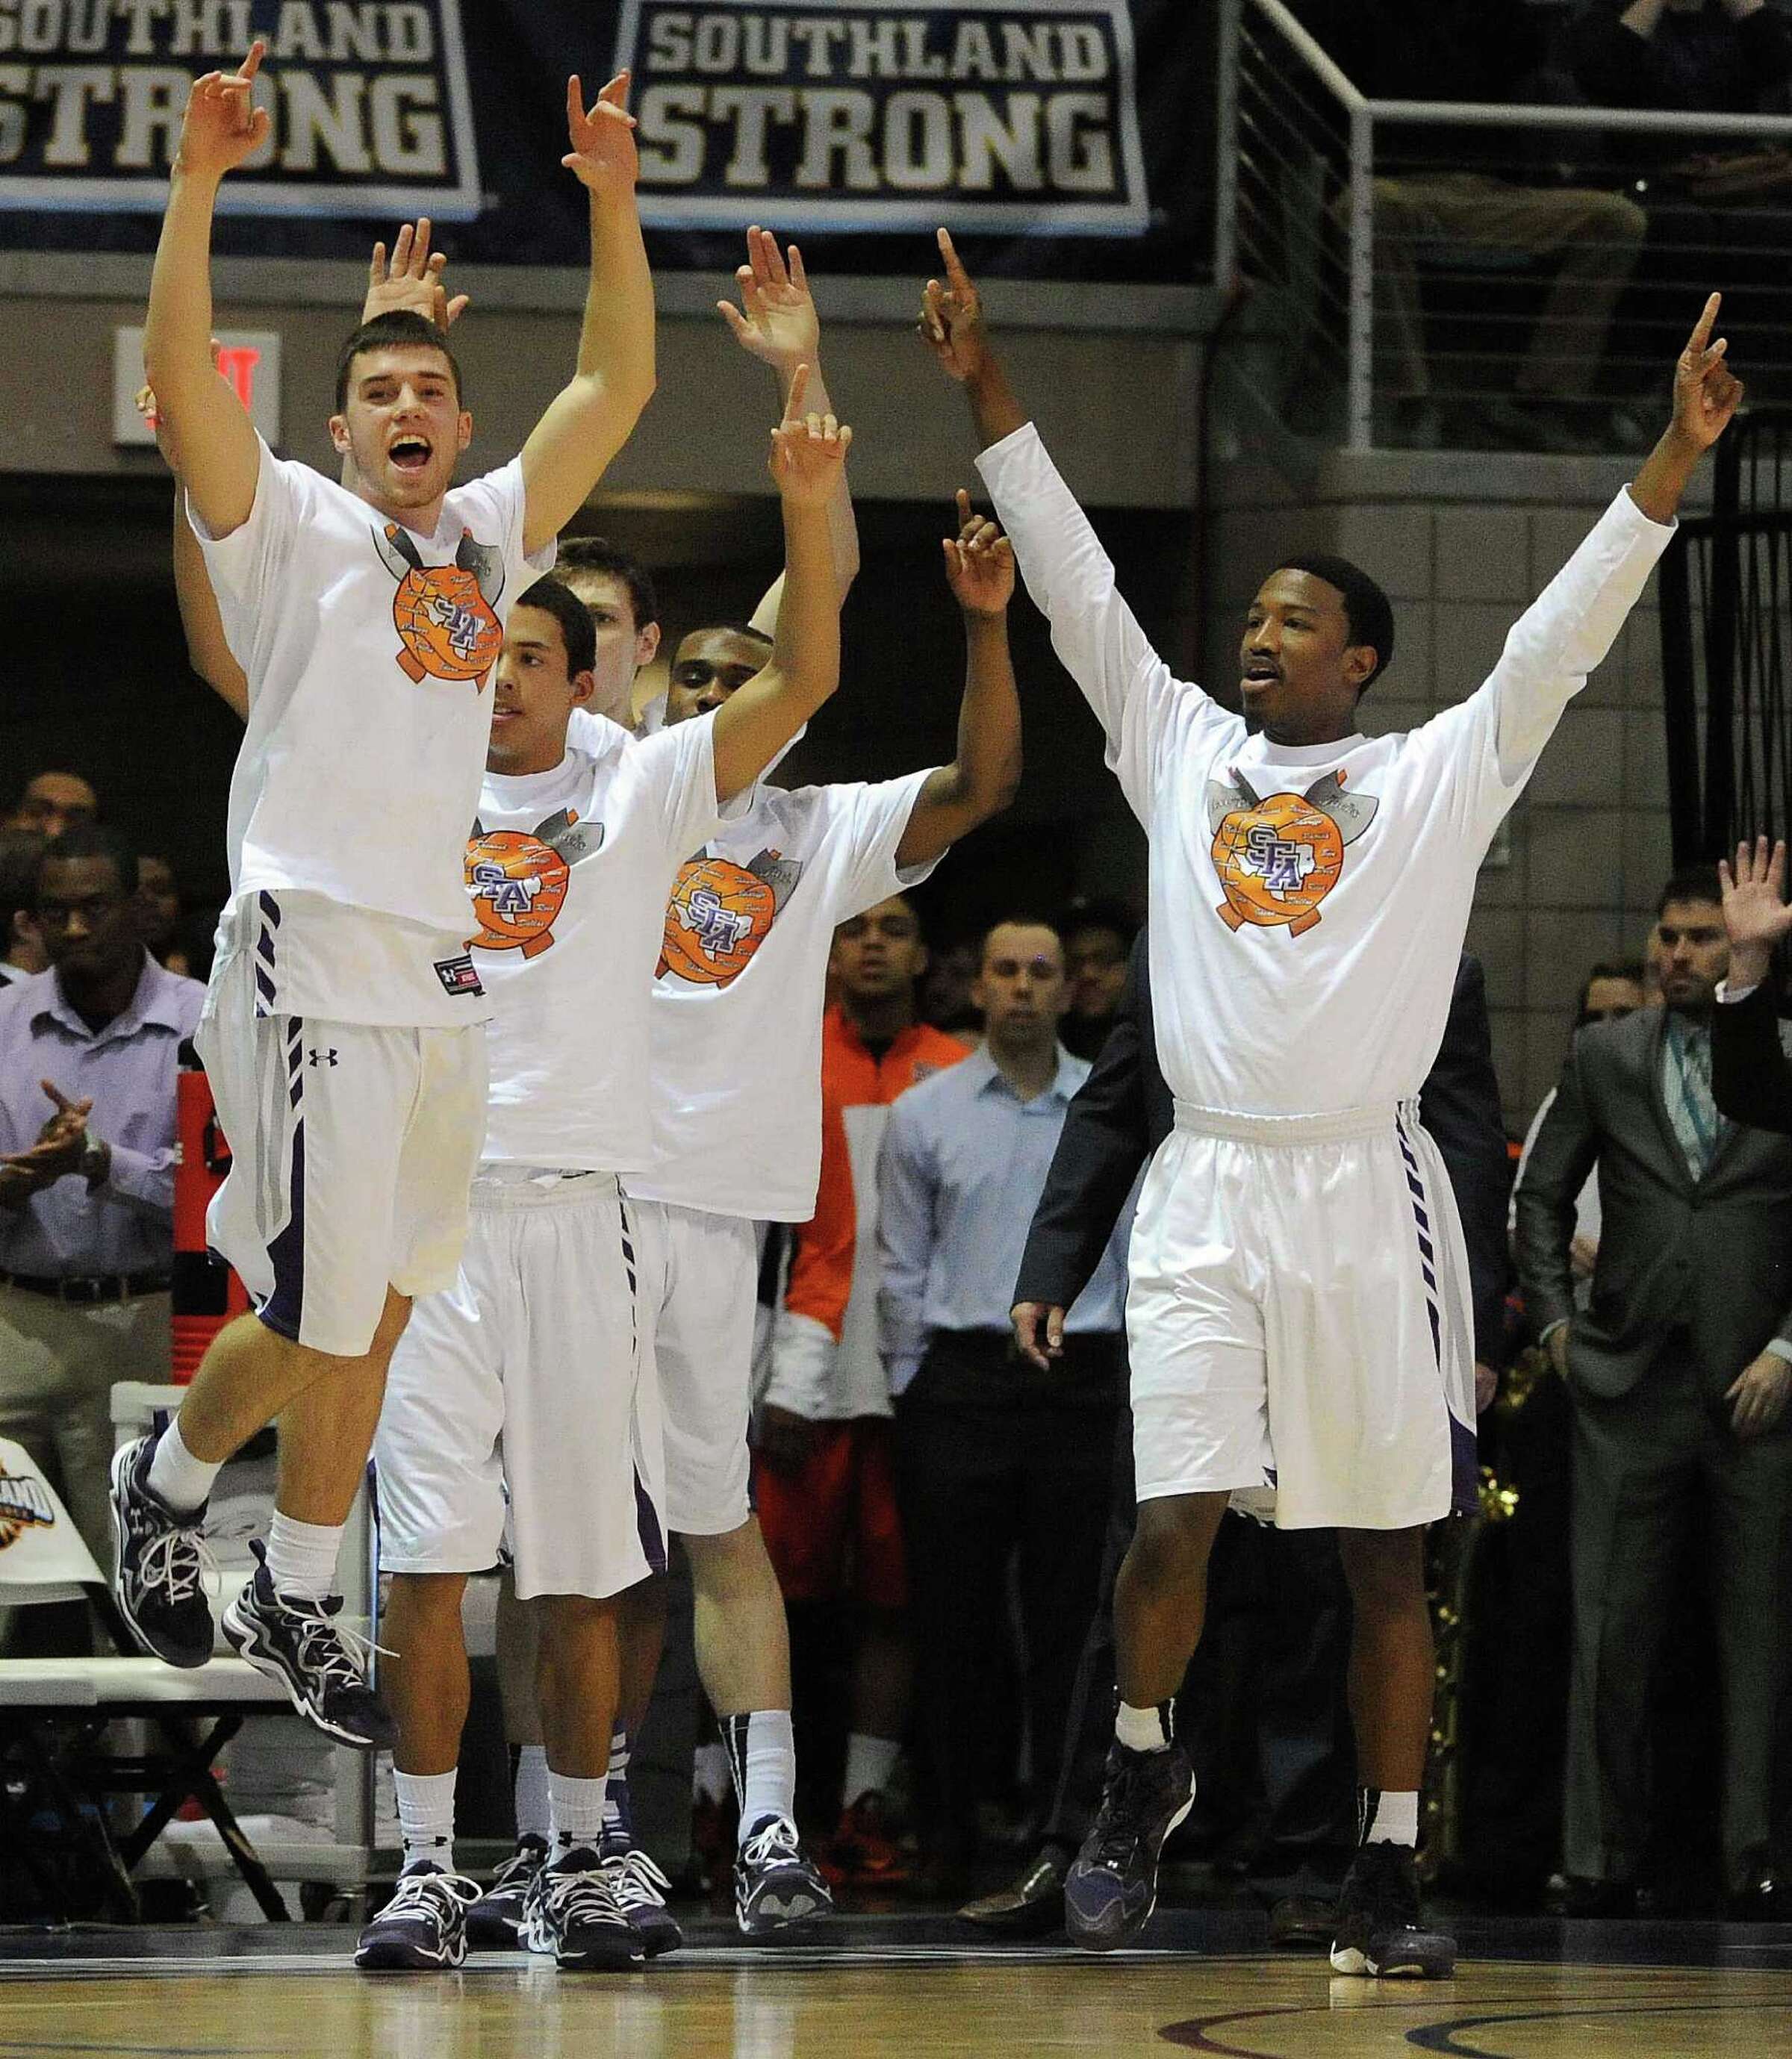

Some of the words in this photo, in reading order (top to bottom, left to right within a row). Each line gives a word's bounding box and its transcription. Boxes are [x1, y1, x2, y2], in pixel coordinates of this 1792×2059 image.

[645, 13, 1108, 82] SOUTHLAND
[638, 84, 1116, 192] STRONG
[1247, 824, 1304, 891] SFA
[689, 888, 738, 955] SFA
